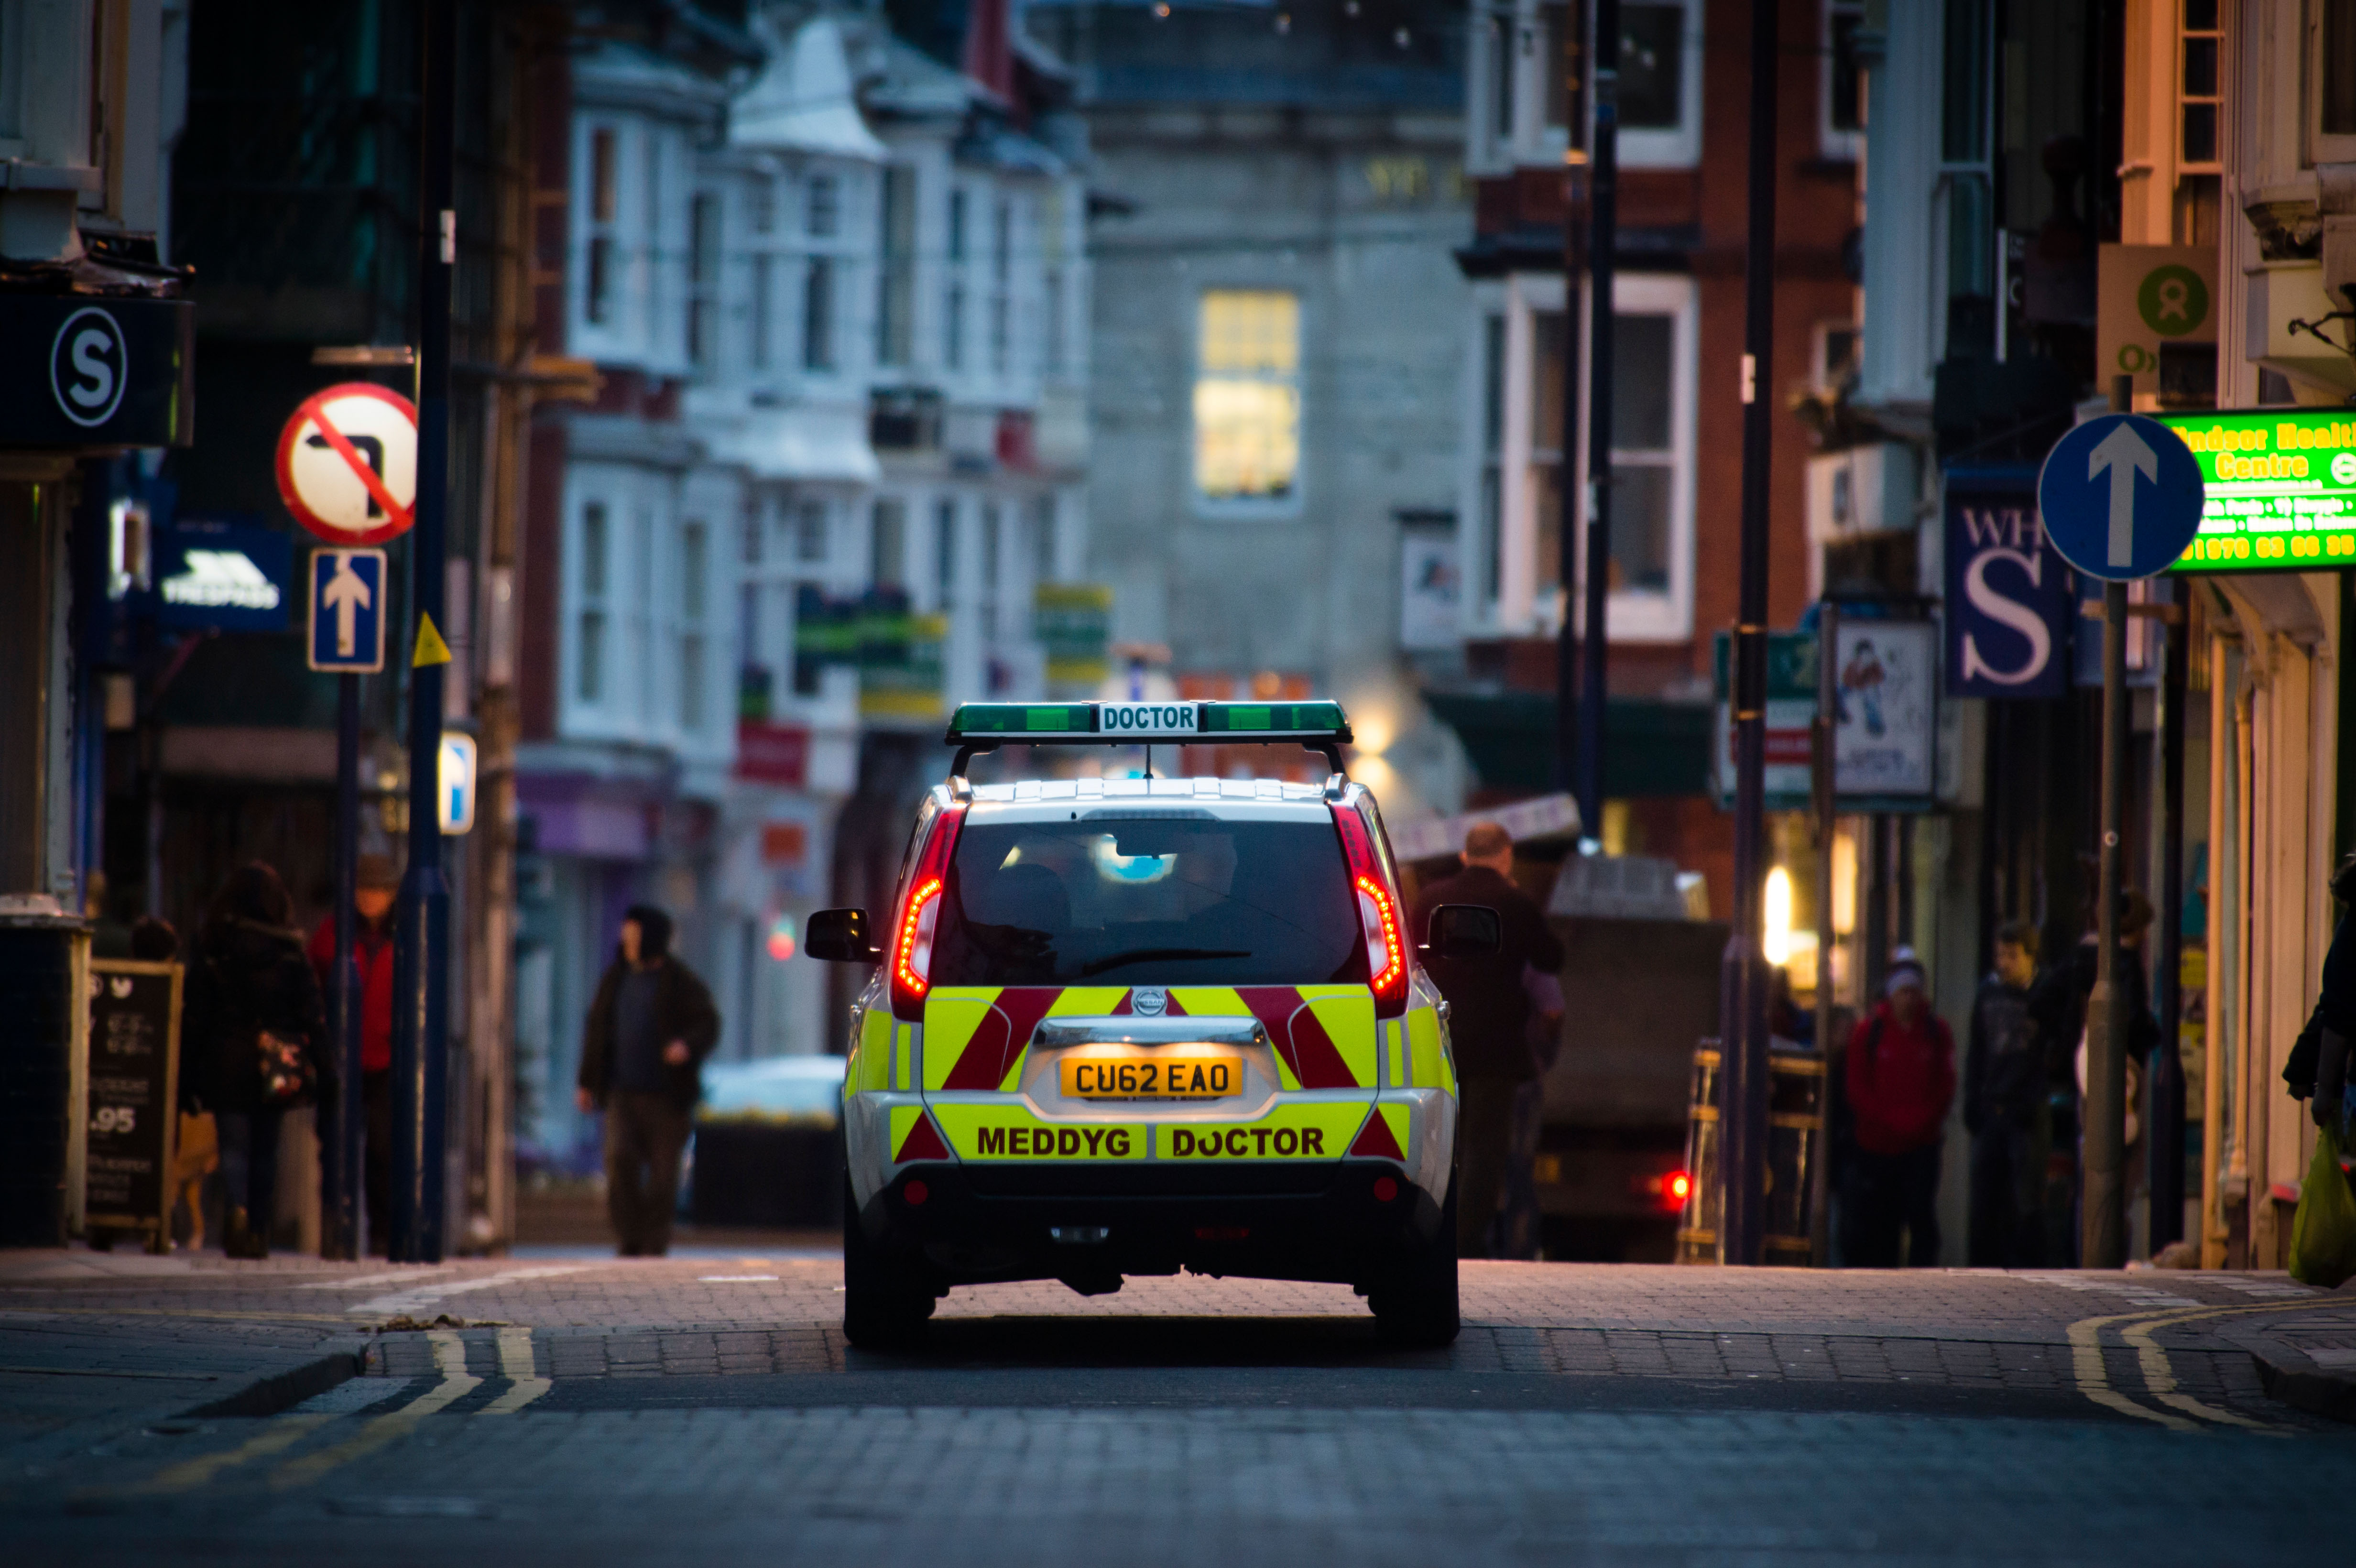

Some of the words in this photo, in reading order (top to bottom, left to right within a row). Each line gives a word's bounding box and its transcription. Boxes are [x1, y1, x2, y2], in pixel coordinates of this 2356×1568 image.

[69, 328, 113, 407] S
[2215, 451, 2309, 480] Centre
[1962, 507, 2044, 548] WH
[2255, 536, 2285, 558] 63
[1962, 546, 2051, 686] S
[1104, 707, 1194, 730] DOCTOR
[1076, 1063, 1159, 1093] CU62
[1167, 1063, 1229, 1093] EAO
[977, 1127, 1130, 1156] MEDDYG
[1173, 1127, 1325, 1156] DOCTOR
